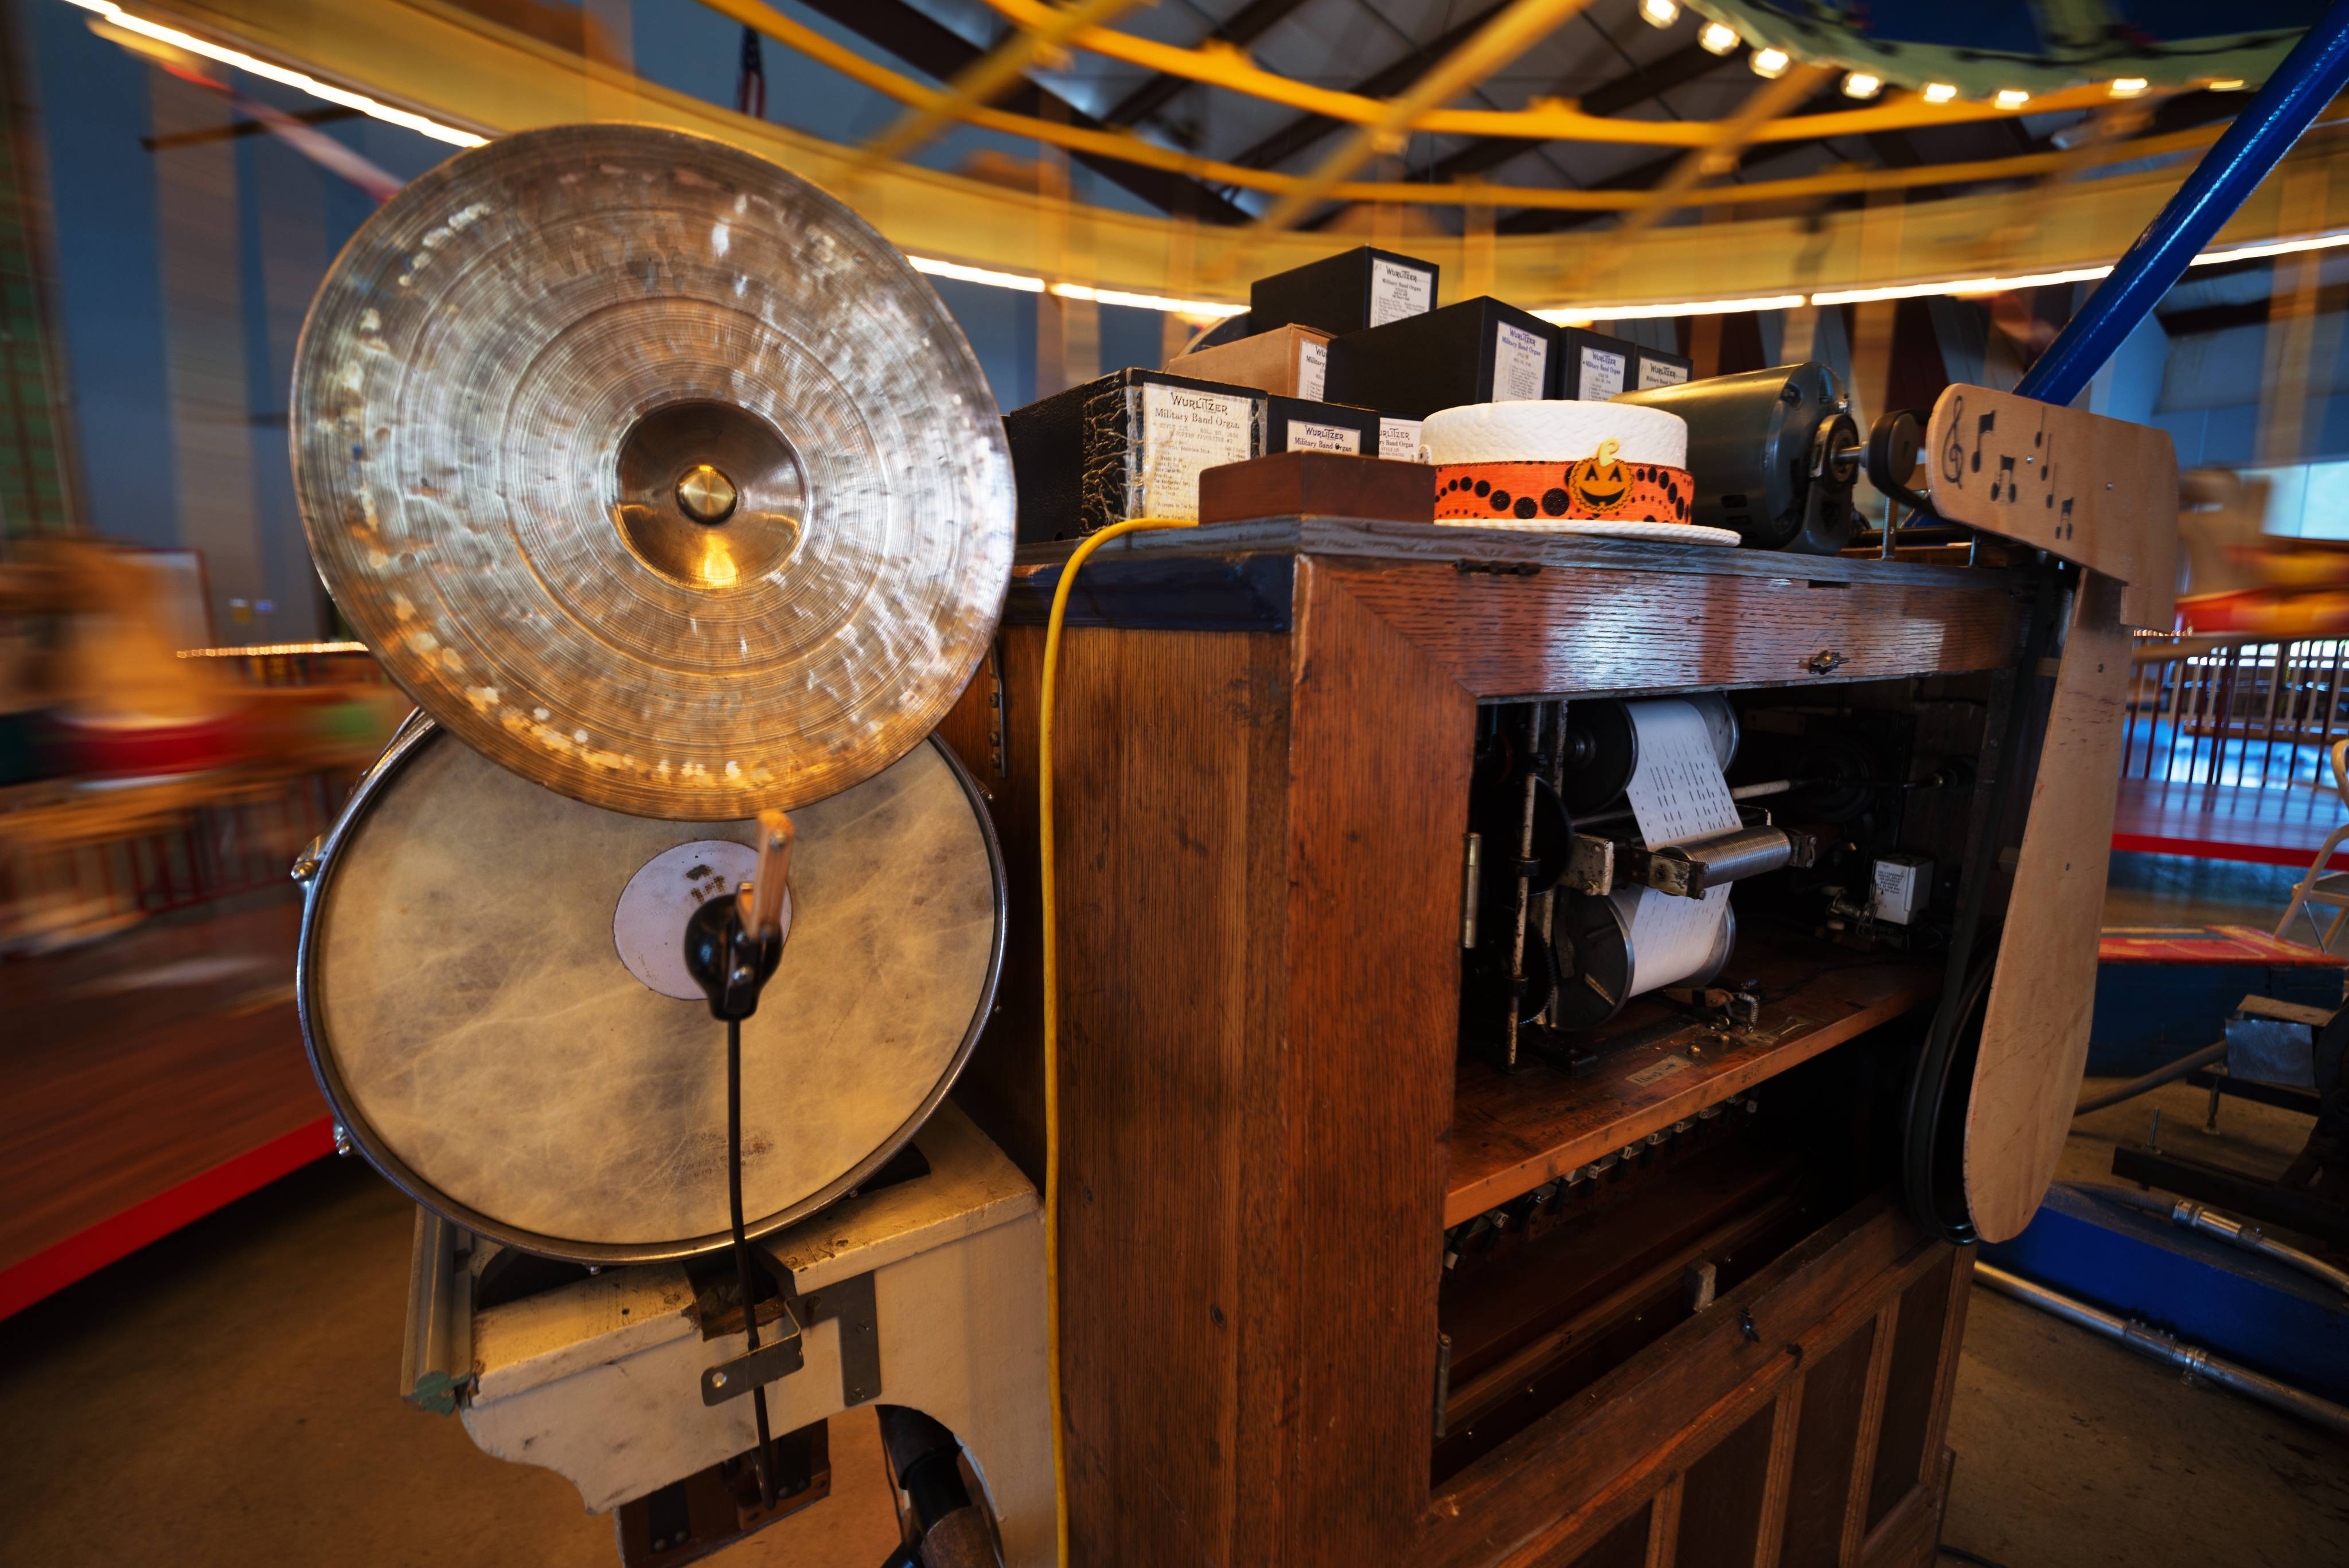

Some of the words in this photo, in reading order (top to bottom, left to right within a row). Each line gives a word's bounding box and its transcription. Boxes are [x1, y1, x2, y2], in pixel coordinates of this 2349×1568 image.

[1382, 278, 1398, 286] Military
[1386, 266, 1417, 282] WURLITZER
[1509, 327, 1536, 346] WURLITZER
[1502, 336, 1517, 348] Military
[1518, 342, 1528, 352] Band
[1529, 346, 1541, 356] Organ
[1306, 356, 1325, 368] Military
[1586, 360, 1599, 369] Military
[1593, 352, 1616, 366] WURLITZER
[1650, 363, 1676, 379] WURLITZER
[1170, 392, 1228, 416] WURLITZER
[1155, 408, 1188, 423] Military
[1192, 413, 1213, 425] Band
[1216, 417, 1239, 430] Organ
[1305, 425, 1344, 442] WURLITZER
[1379, 428, 1410, 440] URLITZER
[1294, 437, 1317, 448] Military
[1319, 440, 1333, 449] Band
[1335, 443, 1352, 452] Organ
